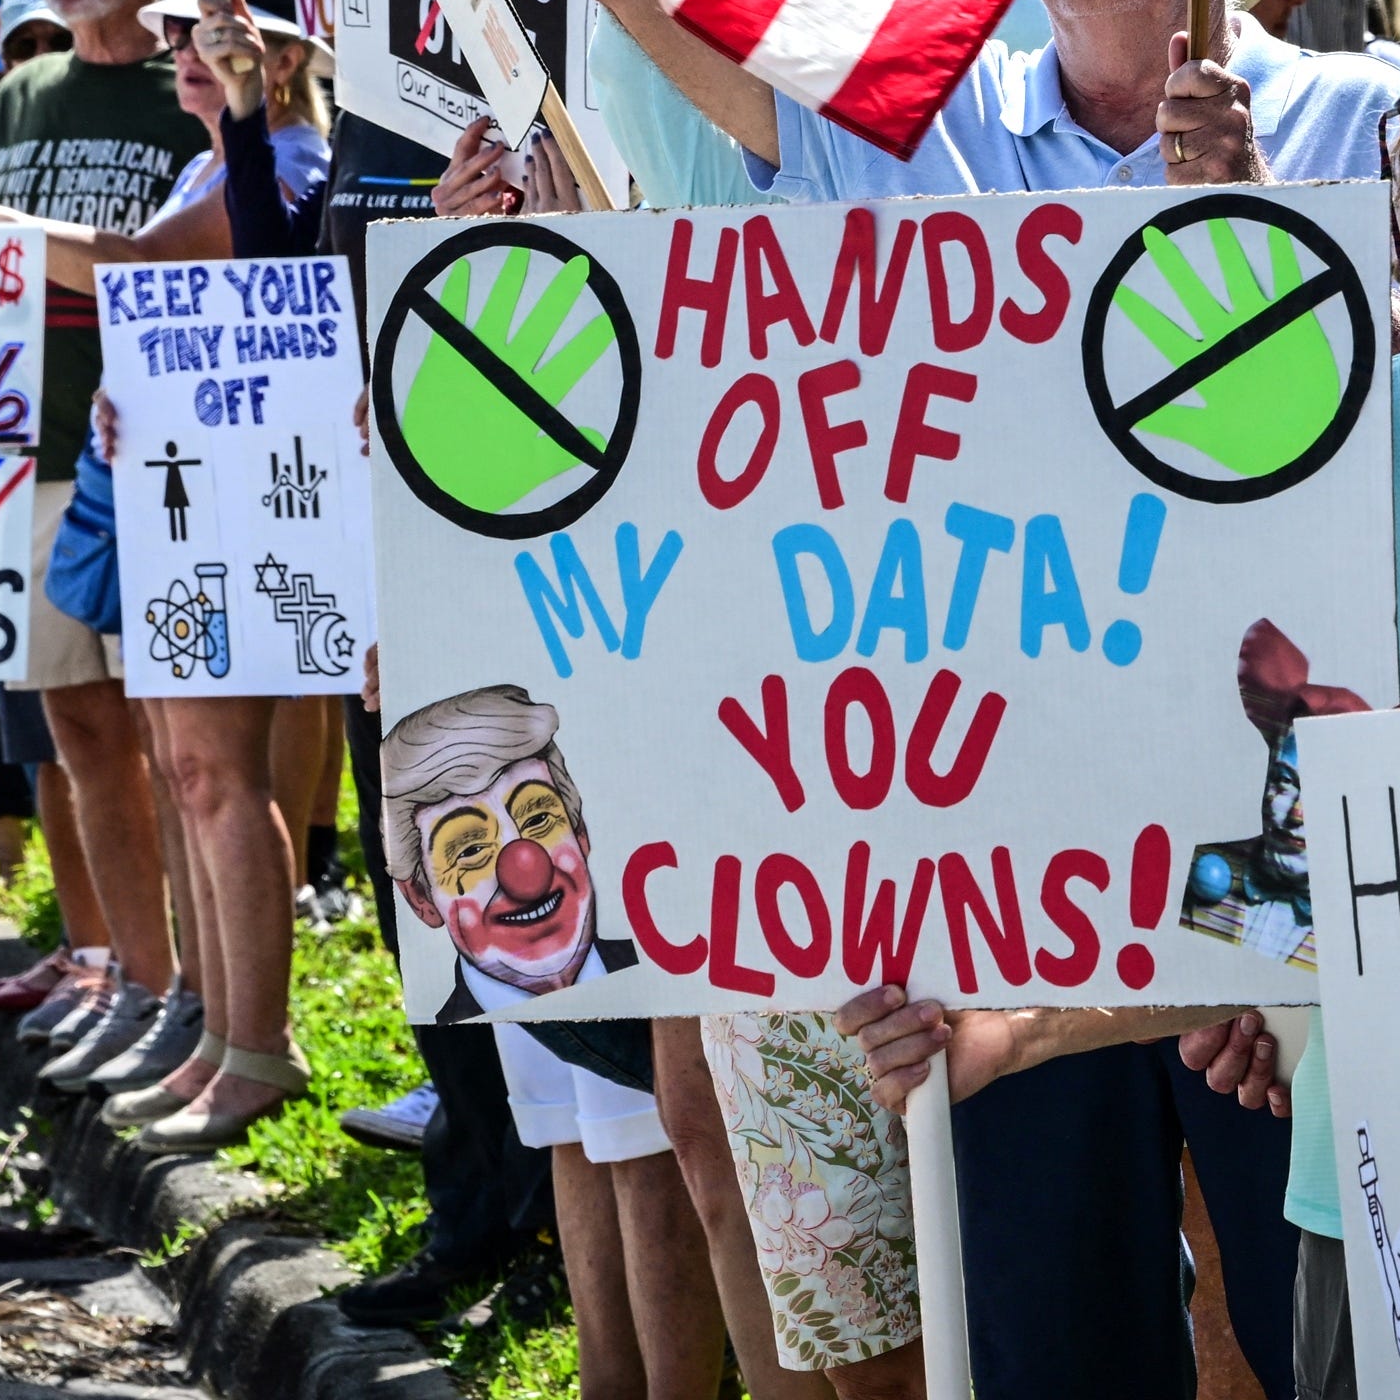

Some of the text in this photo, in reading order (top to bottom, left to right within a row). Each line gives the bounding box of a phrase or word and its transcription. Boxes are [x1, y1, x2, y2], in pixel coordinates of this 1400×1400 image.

[400, 69, 430, 99] Our
[101, 260, 342, 325] KEEP YOUR
[138, 317, 340, 378] TINY HANDS
[653, 202, 1085, 368] HANDS
[193, 375, 271, 427] OFF
[695, 358, 980, 512] OFF
[513, 491, 1167, 679] MY DATA!
[717, 666, 1007, 815] YOU
[621, 822, 1173, 998] CLOWNS!
